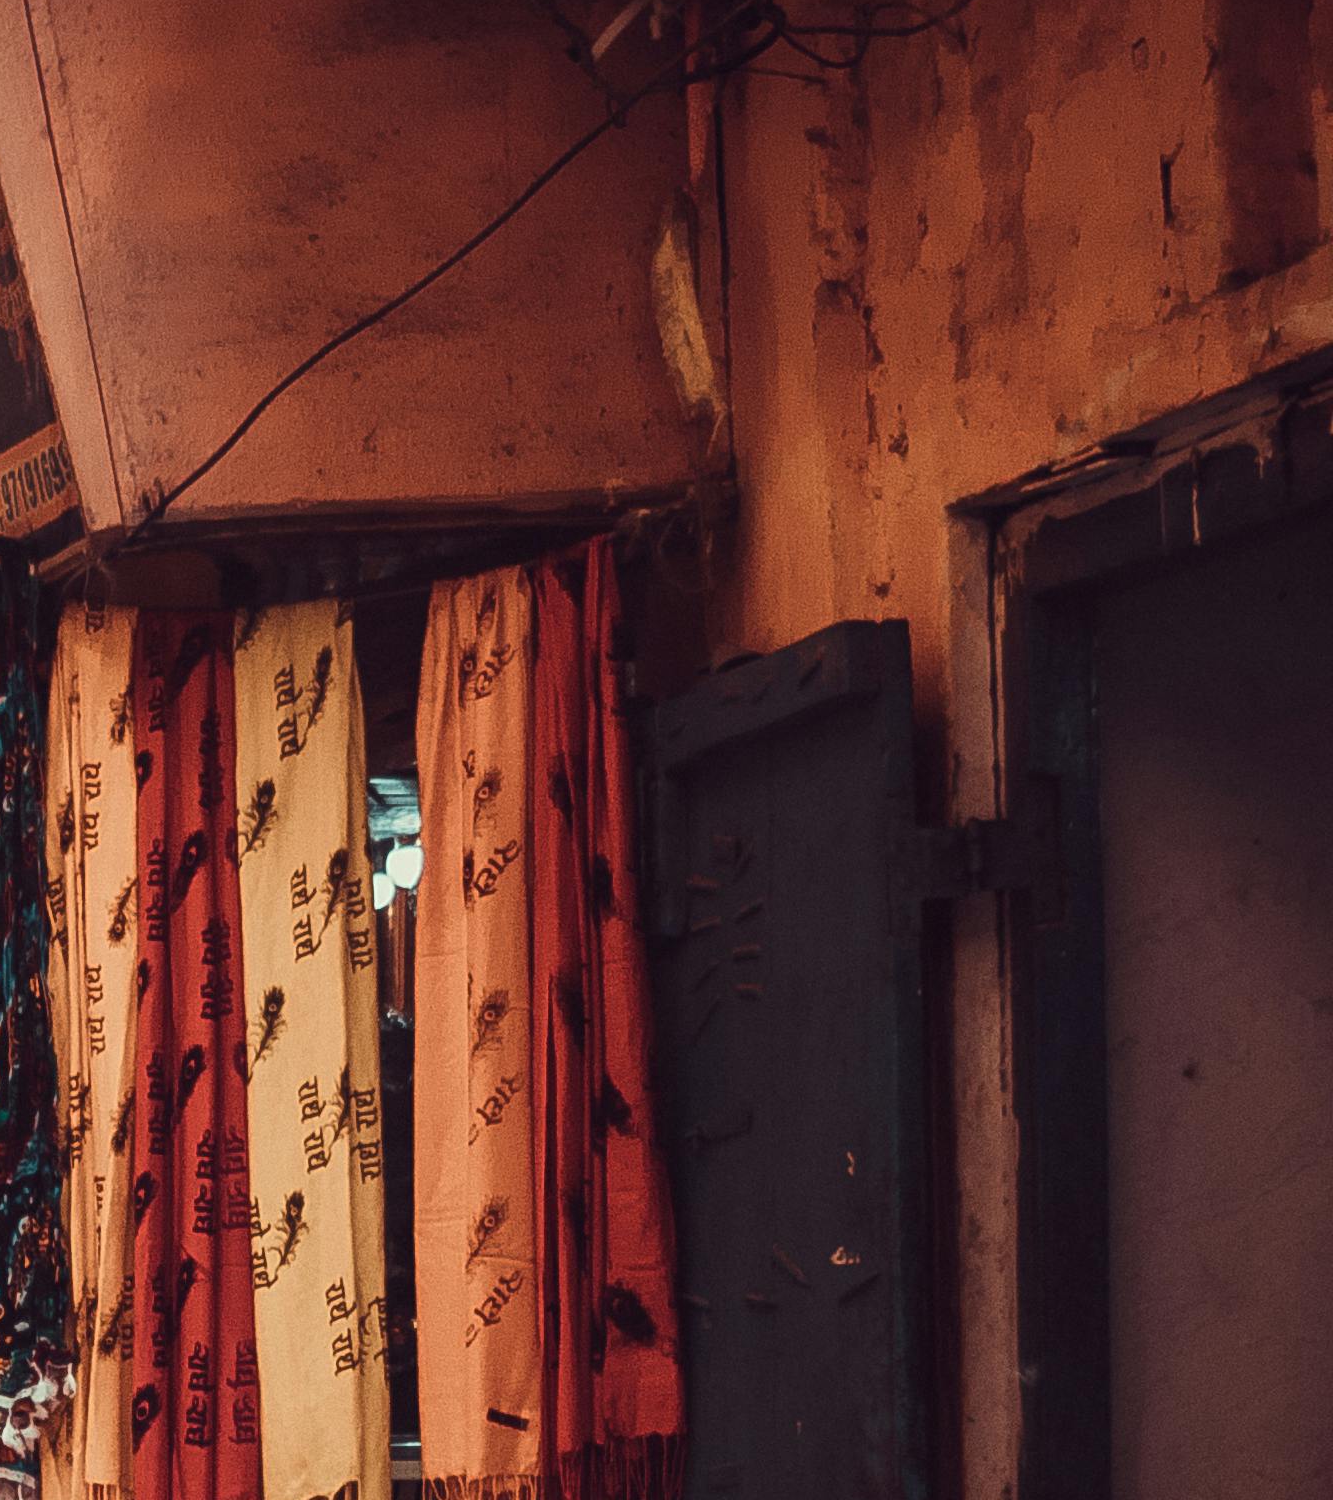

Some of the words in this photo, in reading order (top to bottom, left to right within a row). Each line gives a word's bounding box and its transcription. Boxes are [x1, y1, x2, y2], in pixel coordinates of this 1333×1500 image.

[290, 863, 317, 909] राधे
[294, 914, 321, 963] राधे
[299, 1075, 326, 1123] राधे
[304, 1127, 333, 1174] राधे
[326, 1277, 357, 1325] राधे
[332, 1327, 361, 1377] राधे
